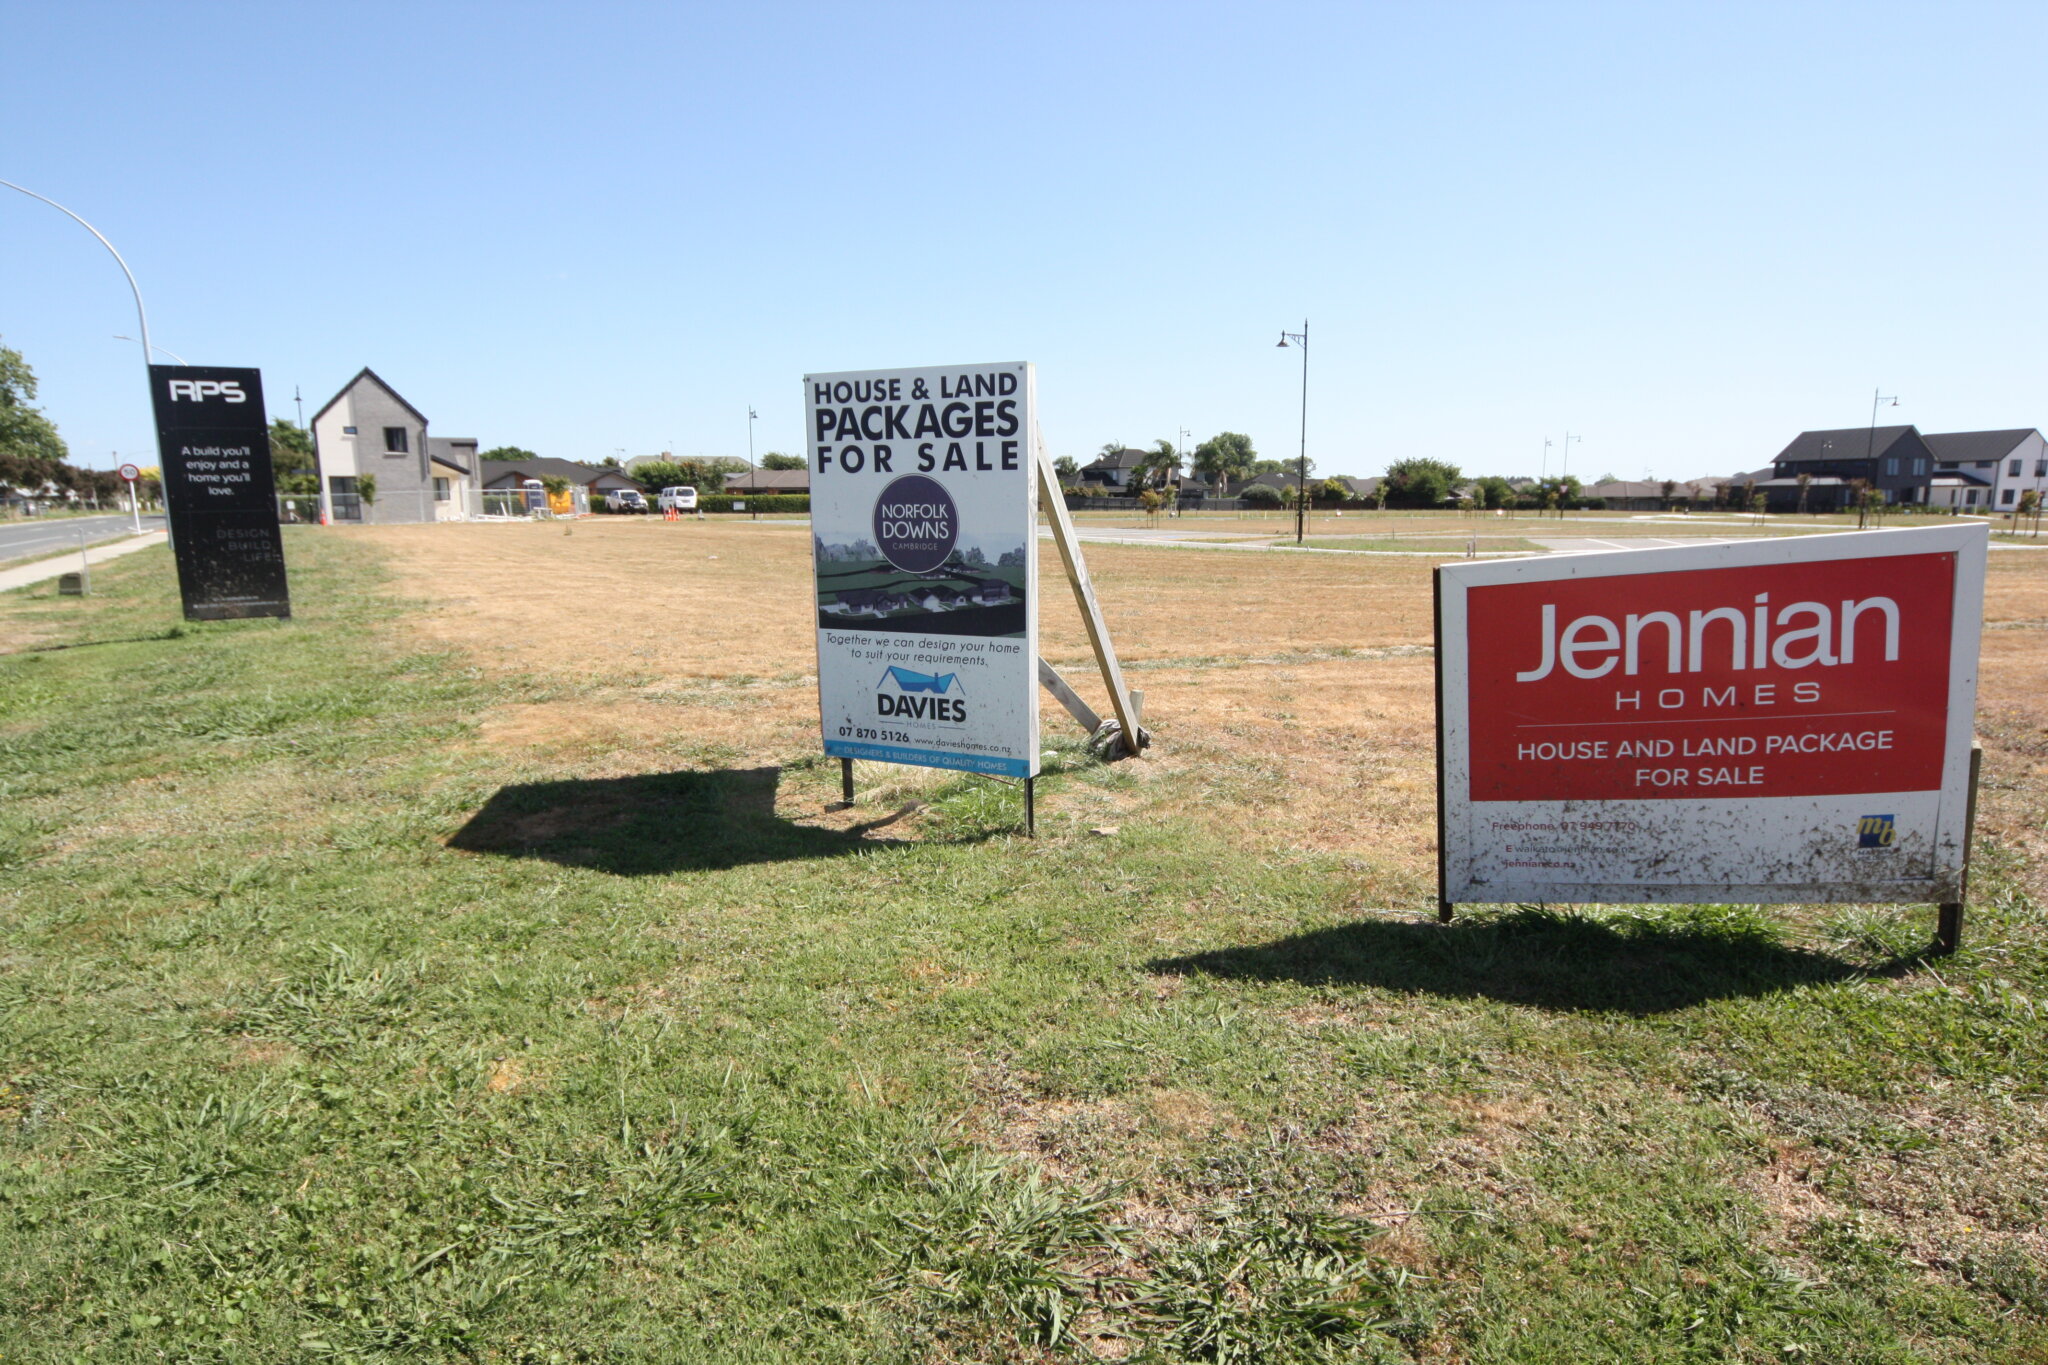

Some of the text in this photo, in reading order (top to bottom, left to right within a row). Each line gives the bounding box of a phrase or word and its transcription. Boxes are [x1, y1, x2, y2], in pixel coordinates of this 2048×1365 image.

[815, 373, 1018, 404] HOUSE & LAND
[816, 400, 1019, 442] PACKAGES
[182, 447, 190, 455] A
[193, 447, 219, 455] build
[818, 441, 1018, 473] FOR SALE
[186, 461, 216, 471] enjoy
[219, 460, 240, 468] and
[188, 473, 220, 482] home
[208, 487, 234, 495] love.
[882, 504, 948, 518] NORFOLK
[883, 521, 948, 539] DOWNS
[826, 633, 1020, 654] Together we can design your home
[1516, 591, 1901, 682] Jennian
[851, 649, 989, 666] to suit your requirements.
[1615, 681, 1822, 711] HOMES
[878, 694, 967, 722] DAVIES
[906, 721, 937, 730] HOMES
[839, 726, 1011, 754] 07 870 5126 www.davieshomes.co.nz
[1518, 730, 1894, 761] HOUSE AND LAND PACKAGE
[844, 746, 884, 759] DESIGNERS
[892, 752, 927, 763] BUILDERS
[929, 755, 941, 764] OF
[943, 757, 976, 769] QUALITY
[977, 760, 1008, 771] HOMES
[1635, 766, 1764, 787] FOR SALE
